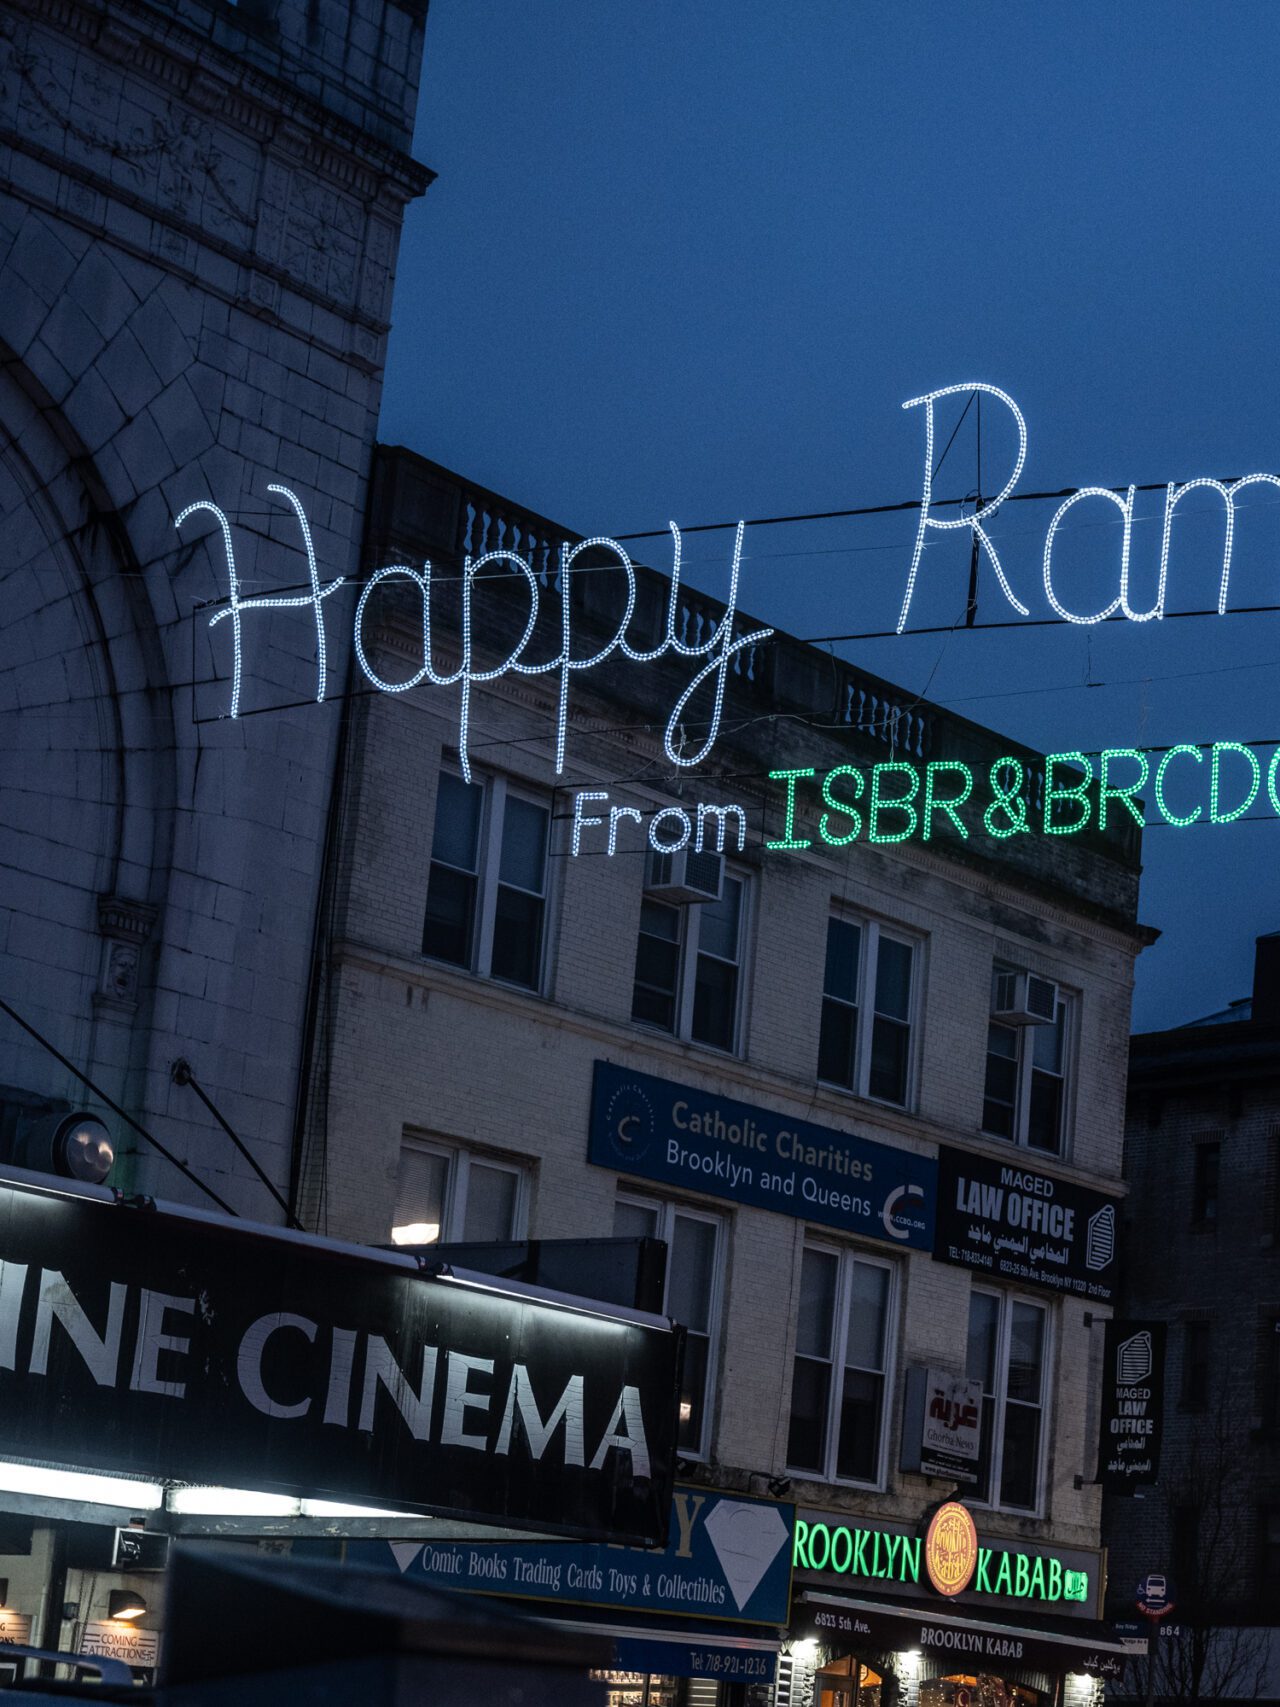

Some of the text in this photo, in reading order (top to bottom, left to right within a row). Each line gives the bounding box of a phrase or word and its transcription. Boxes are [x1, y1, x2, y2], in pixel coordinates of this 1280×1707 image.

[174, 484, 774, 783] Happy
[572, 791, 747, 858] From
[672, 1100, 768, 1153] Catholic
[775, 1130, 873, 1181] Charities
[666, 1139, 753, 1187] Brooklyn
[760, 1171, 796, 1197] and
[802, 1177, 872, 1217] Queens
[1000, 1167, 1054, 1198] MAGED
[956, 1176, 1075, 1242] LAW OFFICE
[968, 1224, 993, 1245] ماجد
[1029, 1242, 1070, 1266] المحامي
[1041, 1270, 1064, 1288] Brooklyn
[1064, 1276, 1073, 1288] NY
[1088, 1282, 1098, 1295] 2nd
[1098, 1284, 1111, 1298] Floor
[237, 1311, 653, 1478] CINEMA
[1116, 1387, 1151, 1399] MAGED
[1118, 1401, 1147, 1416] LAW
[927, 1428, 954, 1446] Ghorba
[1110, 1418, 1154, 1434] OFFICE
[793, 1519, 921, 1584] ROOKLYN
[975, 1546, 1062, 1602] KABAB
[422, 1545, 726, 1605] Comic Books Trading Cards Toys & Collectibles
[814, 1611, 871, 1635] 6823 5th Ave.
[1159, 1625, 1180, 1637] B64
[88, 1645, 147, 1660] ATTRACTIONS
[101, 1633, 138, 1647] COMING
[920, 1627, 1024, 1659] BROOKLYN KABAB
[704, 1653, 767, 1676] 718-921-1236
